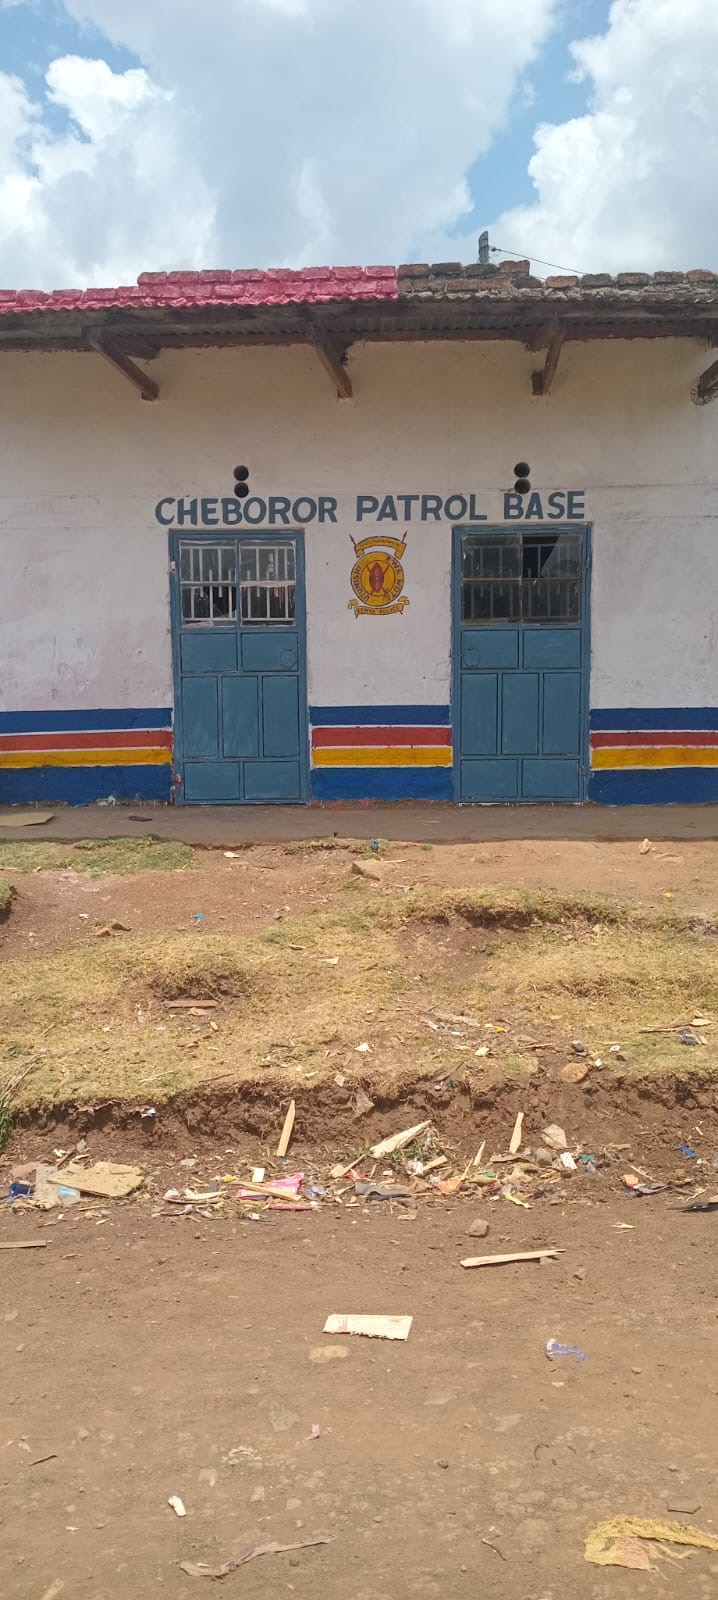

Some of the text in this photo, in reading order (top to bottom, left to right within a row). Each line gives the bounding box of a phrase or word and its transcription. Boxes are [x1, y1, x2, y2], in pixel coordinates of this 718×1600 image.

[155, 491, 584, 526] CHEBOROR PATROL BASE
[353, 564, 370, 602] UTUMISHI
